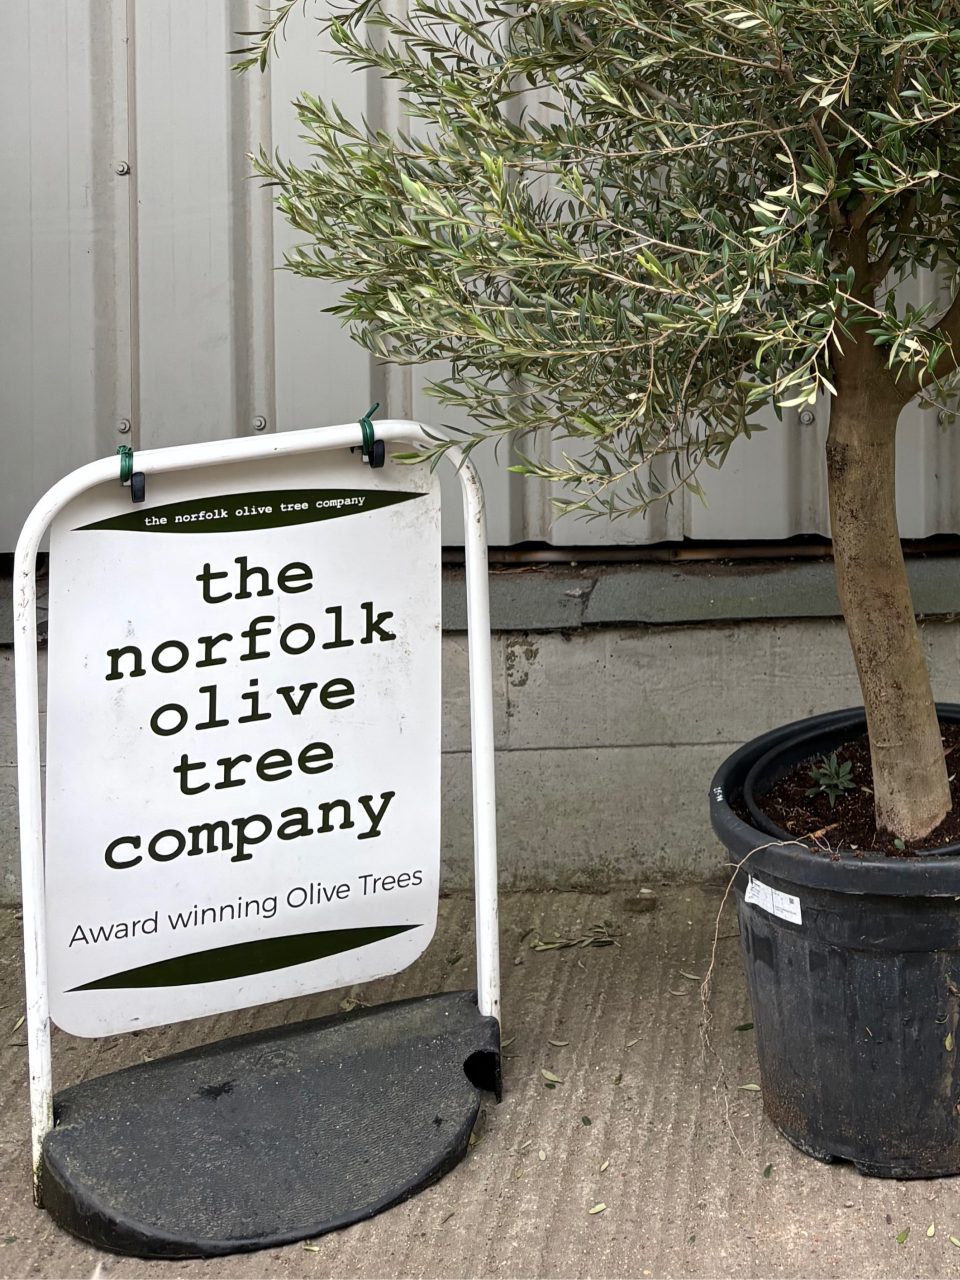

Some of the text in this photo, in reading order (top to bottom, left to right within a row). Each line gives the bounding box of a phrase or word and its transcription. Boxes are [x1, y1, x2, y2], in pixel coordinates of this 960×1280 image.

[144, 496, 366, 526] the norfolk olive tree company
[196, 556, 313, 604] the
[106, 601, 397, 681] norfolk
[151, 677, 355, 737] olive
[174, 741, 334, 796] tree
[104, 790, 396, 870] company
[68, 869, 424, 948] Award winning Olive Trees
